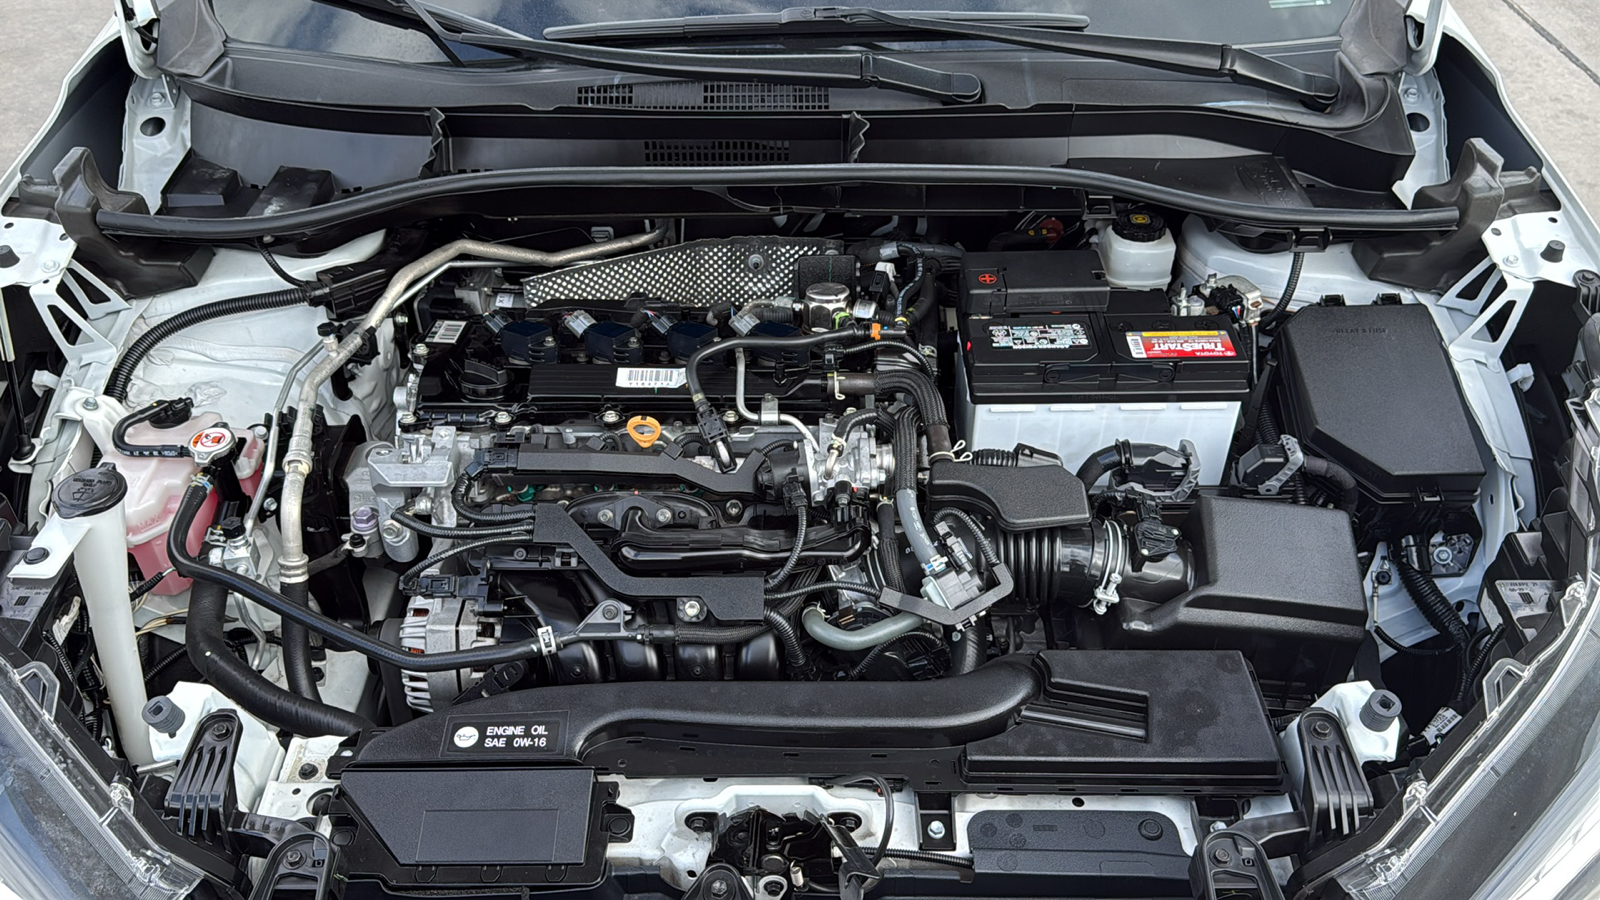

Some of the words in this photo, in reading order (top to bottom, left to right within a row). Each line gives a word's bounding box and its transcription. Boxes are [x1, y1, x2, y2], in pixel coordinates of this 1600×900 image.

[137, 515, 160, 531] MAX
[486, 726, 525, 736] ENGINE
[531, 725, 548, 735] OIL
[484, 738, 506, 747] SAE
[513, 737, 547, 747] 0W-16
